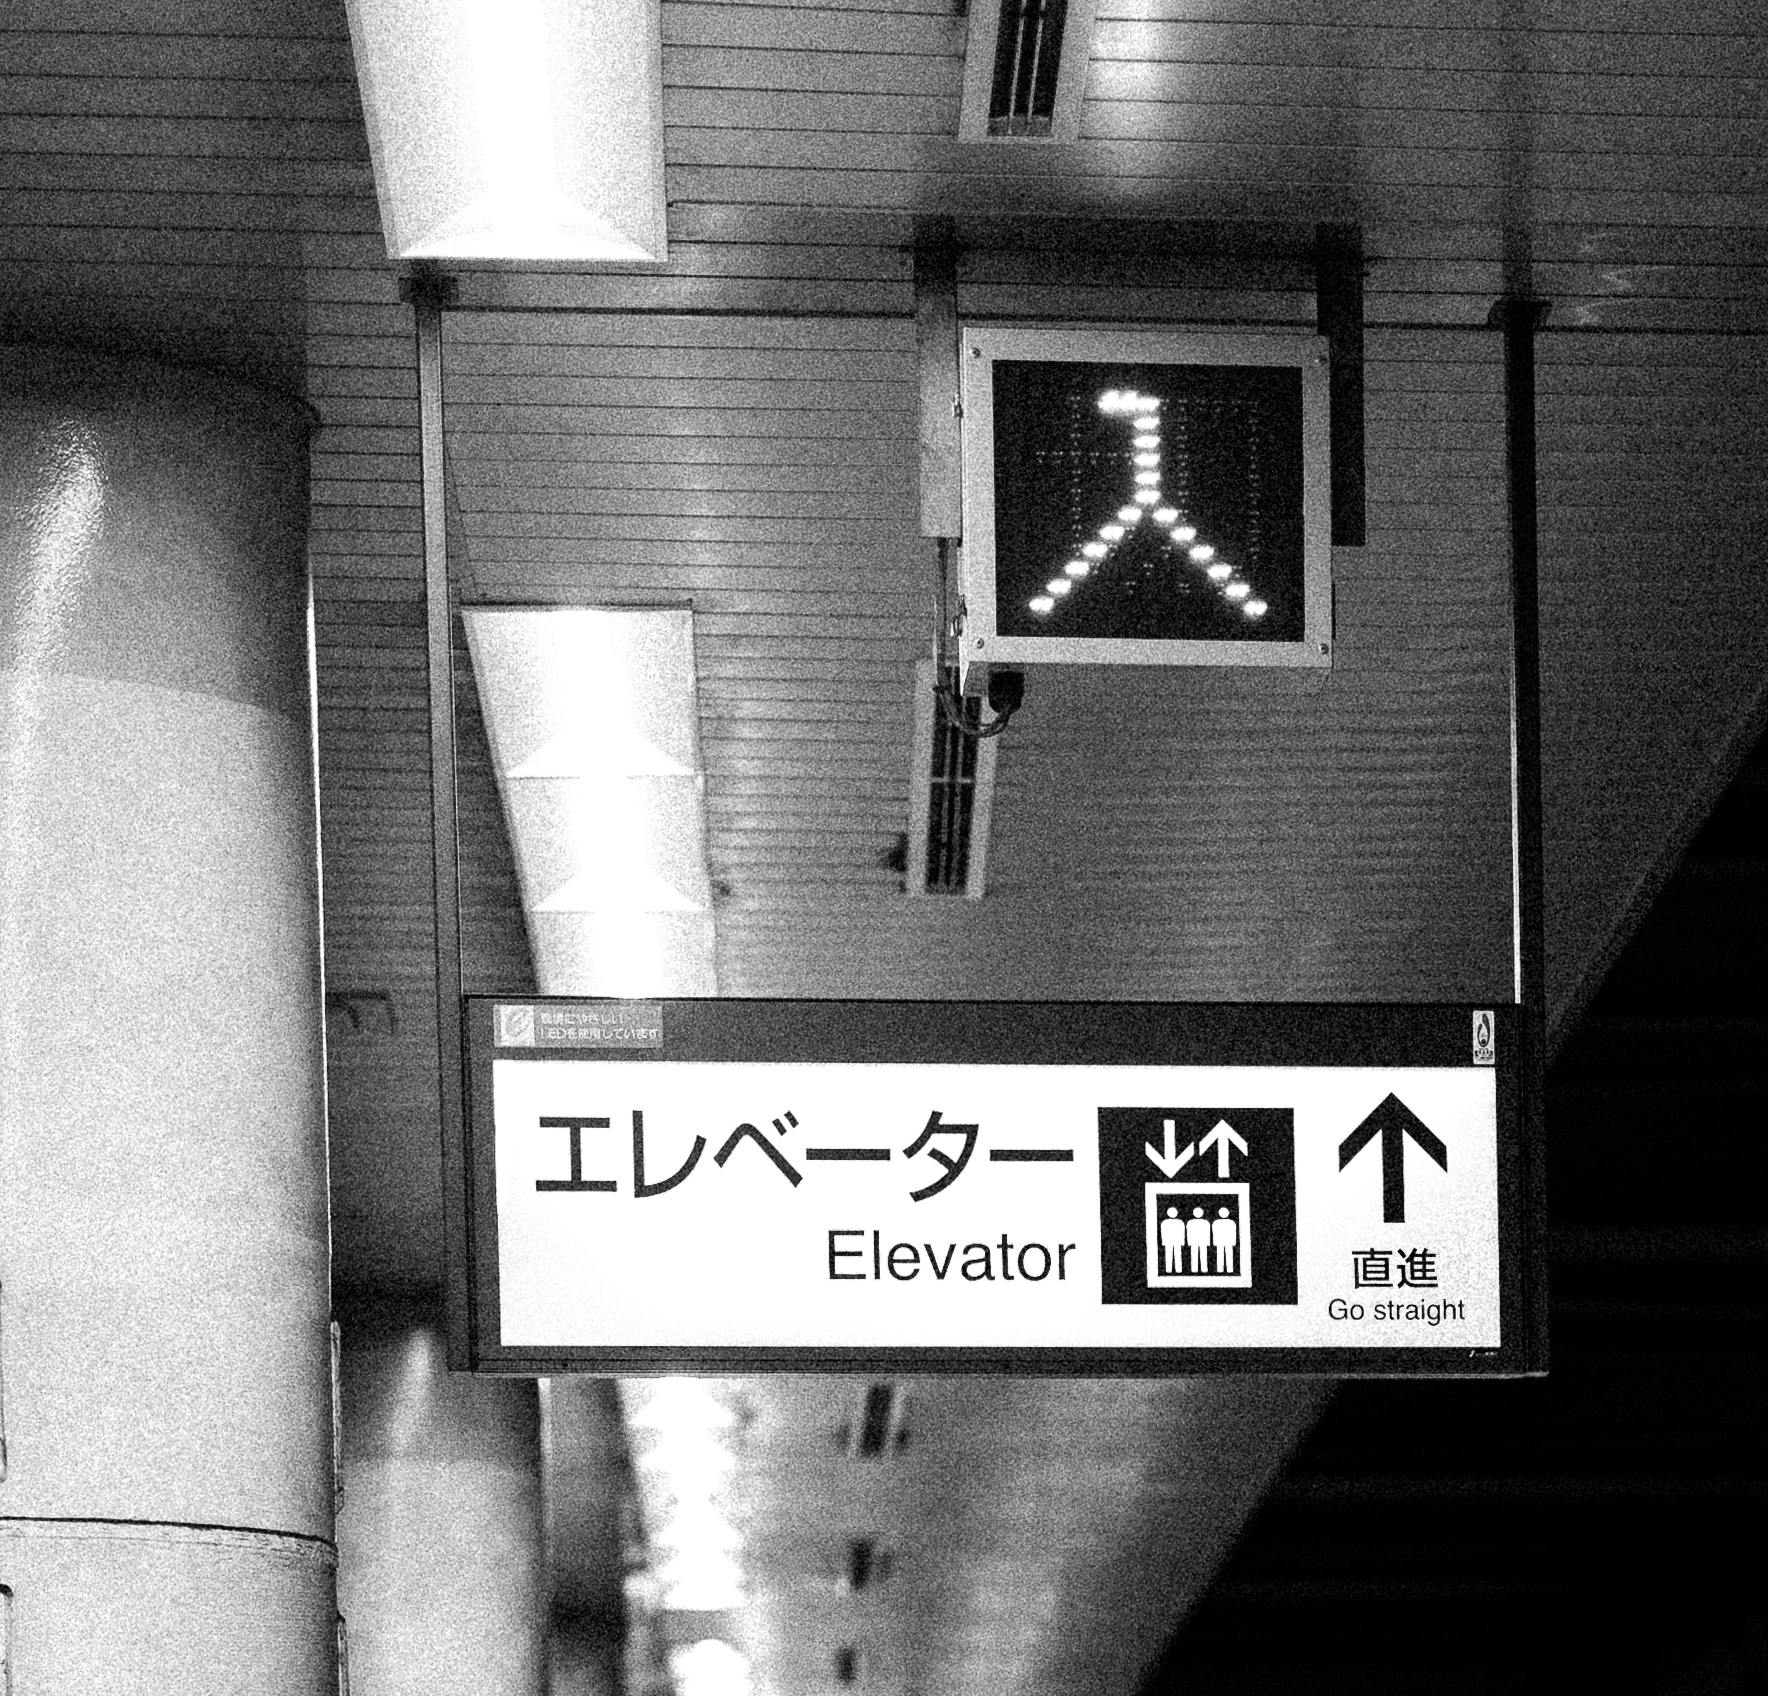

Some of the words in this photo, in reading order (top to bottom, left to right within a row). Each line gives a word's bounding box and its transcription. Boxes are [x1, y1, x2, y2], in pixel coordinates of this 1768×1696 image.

[535, 1109, 1075, 1203] エレベーター
[827, 1229, 1077, 1282] Elevator
[1351, 1247, 1439, 1290] 直進
[1328, 1298, 1365, 1321] Go
[1373, 1298, 1466, 1327] straight
